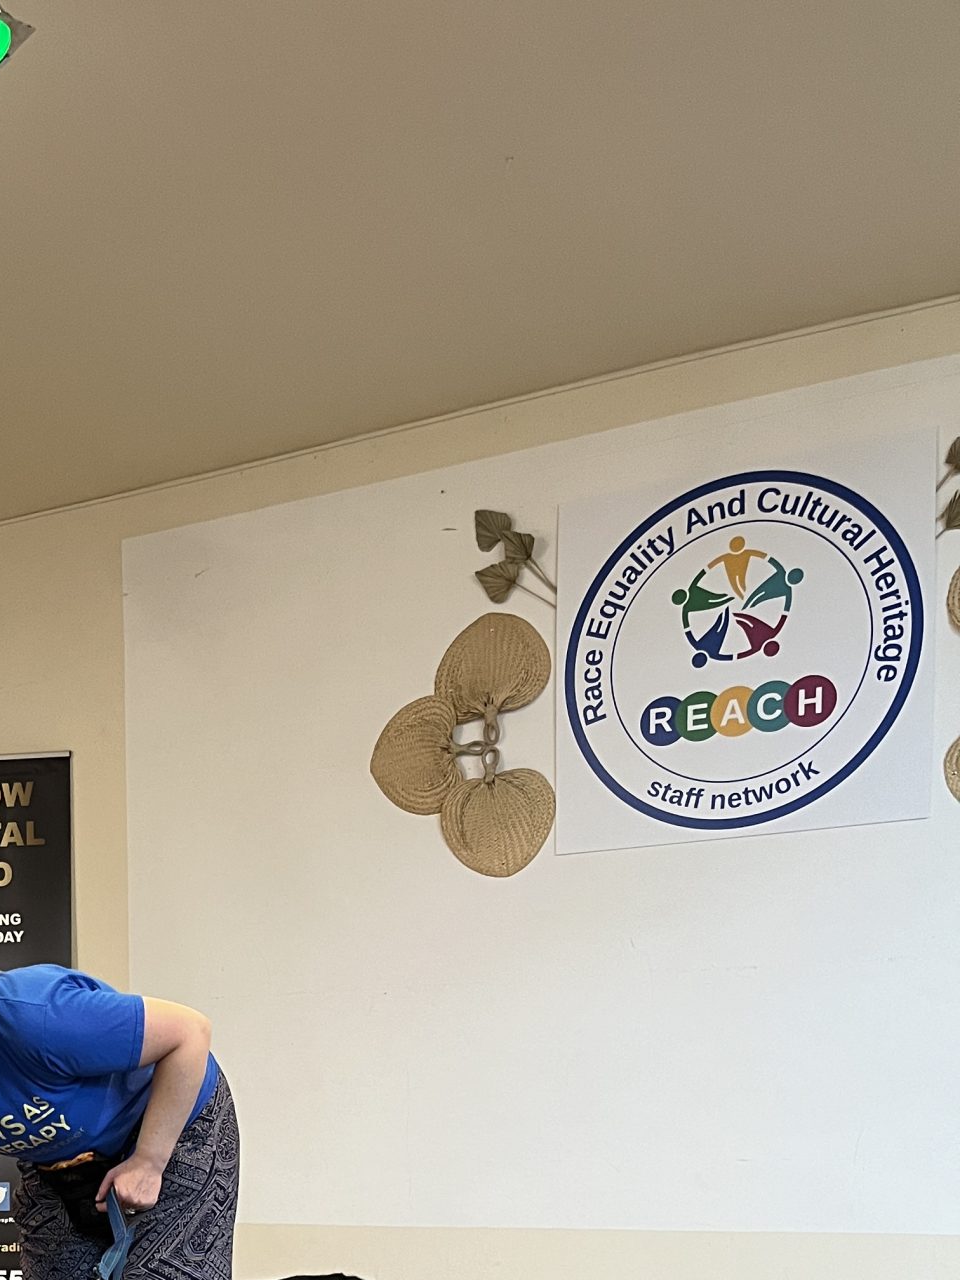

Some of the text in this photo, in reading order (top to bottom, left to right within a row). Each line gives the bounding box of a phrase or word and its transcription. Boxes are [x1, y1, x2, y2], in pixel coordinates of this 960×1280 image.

[582, 487, 909, 727] Race Equality And Cultural Heritage
[648, 686, 824, 735] REACH
[646, 758, 821, 811] staff network
[22, 1096, 50, 1121] AS
